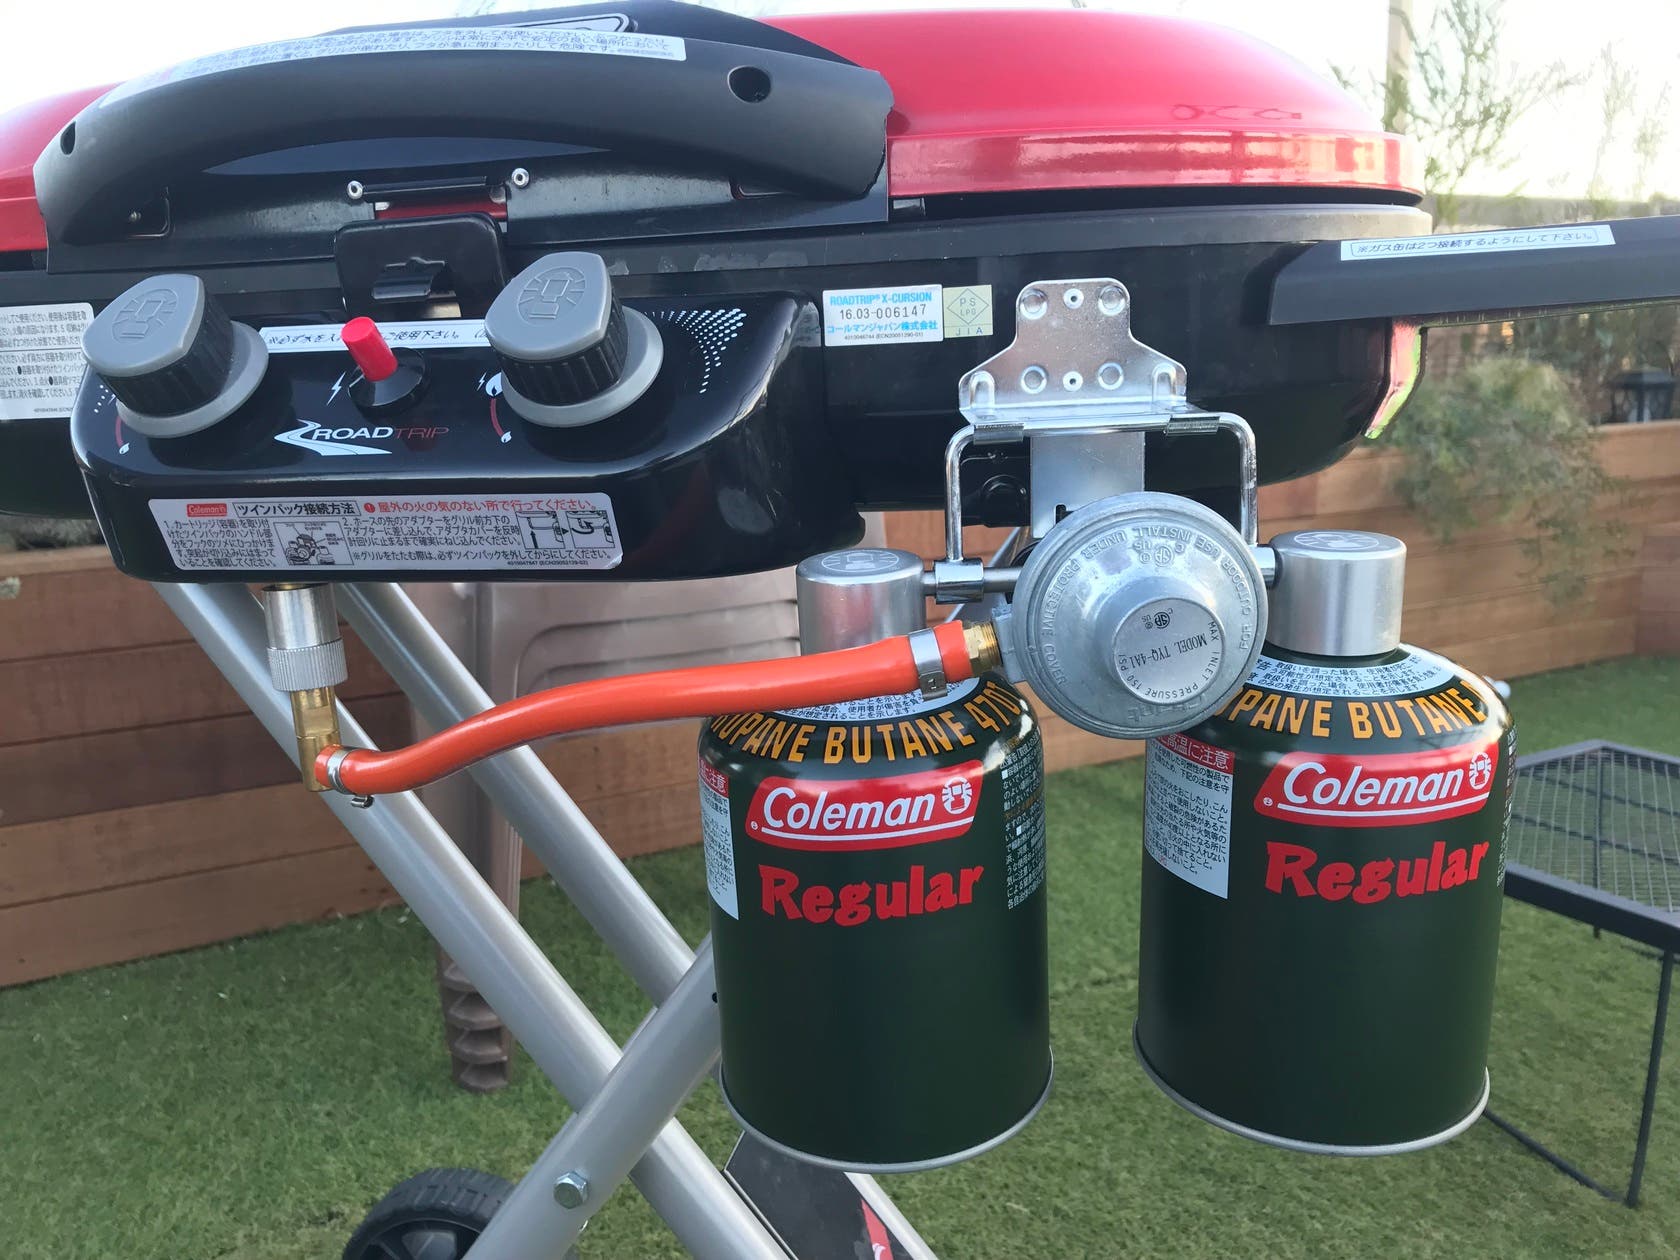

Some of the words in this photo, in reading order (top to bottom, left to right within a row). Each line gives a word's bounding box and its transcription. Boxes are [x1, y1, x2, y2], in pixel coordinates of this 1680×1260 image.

[882, 292, 932, 303] X-CURSION
[840, 304, 926, 320] 16.03-006147
[827, 320, 938, 334] コールマンジャパン株式会社
[188, 505, 220, 514] Coleman
[378, 499, 597, 513] 屋外の火の気のない所で行ってください。
[1083, 530, 1127, 560] UNDER
[1132, 527, 1192, 544] INSTALL
[1195, 535, 1222, 561] USE
[1221, 557, 1252, 617] OUTDOOR
[1173, 634, 1208, 655] MODEL
[1208, 621, 1220, 642] MAX
[1043, 645, 1068, 686] COVER
[1202, 651, 1220, 682] INLET
[1126, 675, 1143, 690] 150
[1145, 682, 1199, 699] PRESSURE
[1216, 688, 1332, 738] PANE
[1347, 688, 1488, 739] BUTANE
[823, 710, 977, 764] BUTANE
[1283, 761, 1465, 806] Coleman
[763, 786, 936, 831] Coleman
[1264, 840, 1490, 905] Regular
[758, 864, 985, 927] Regular
